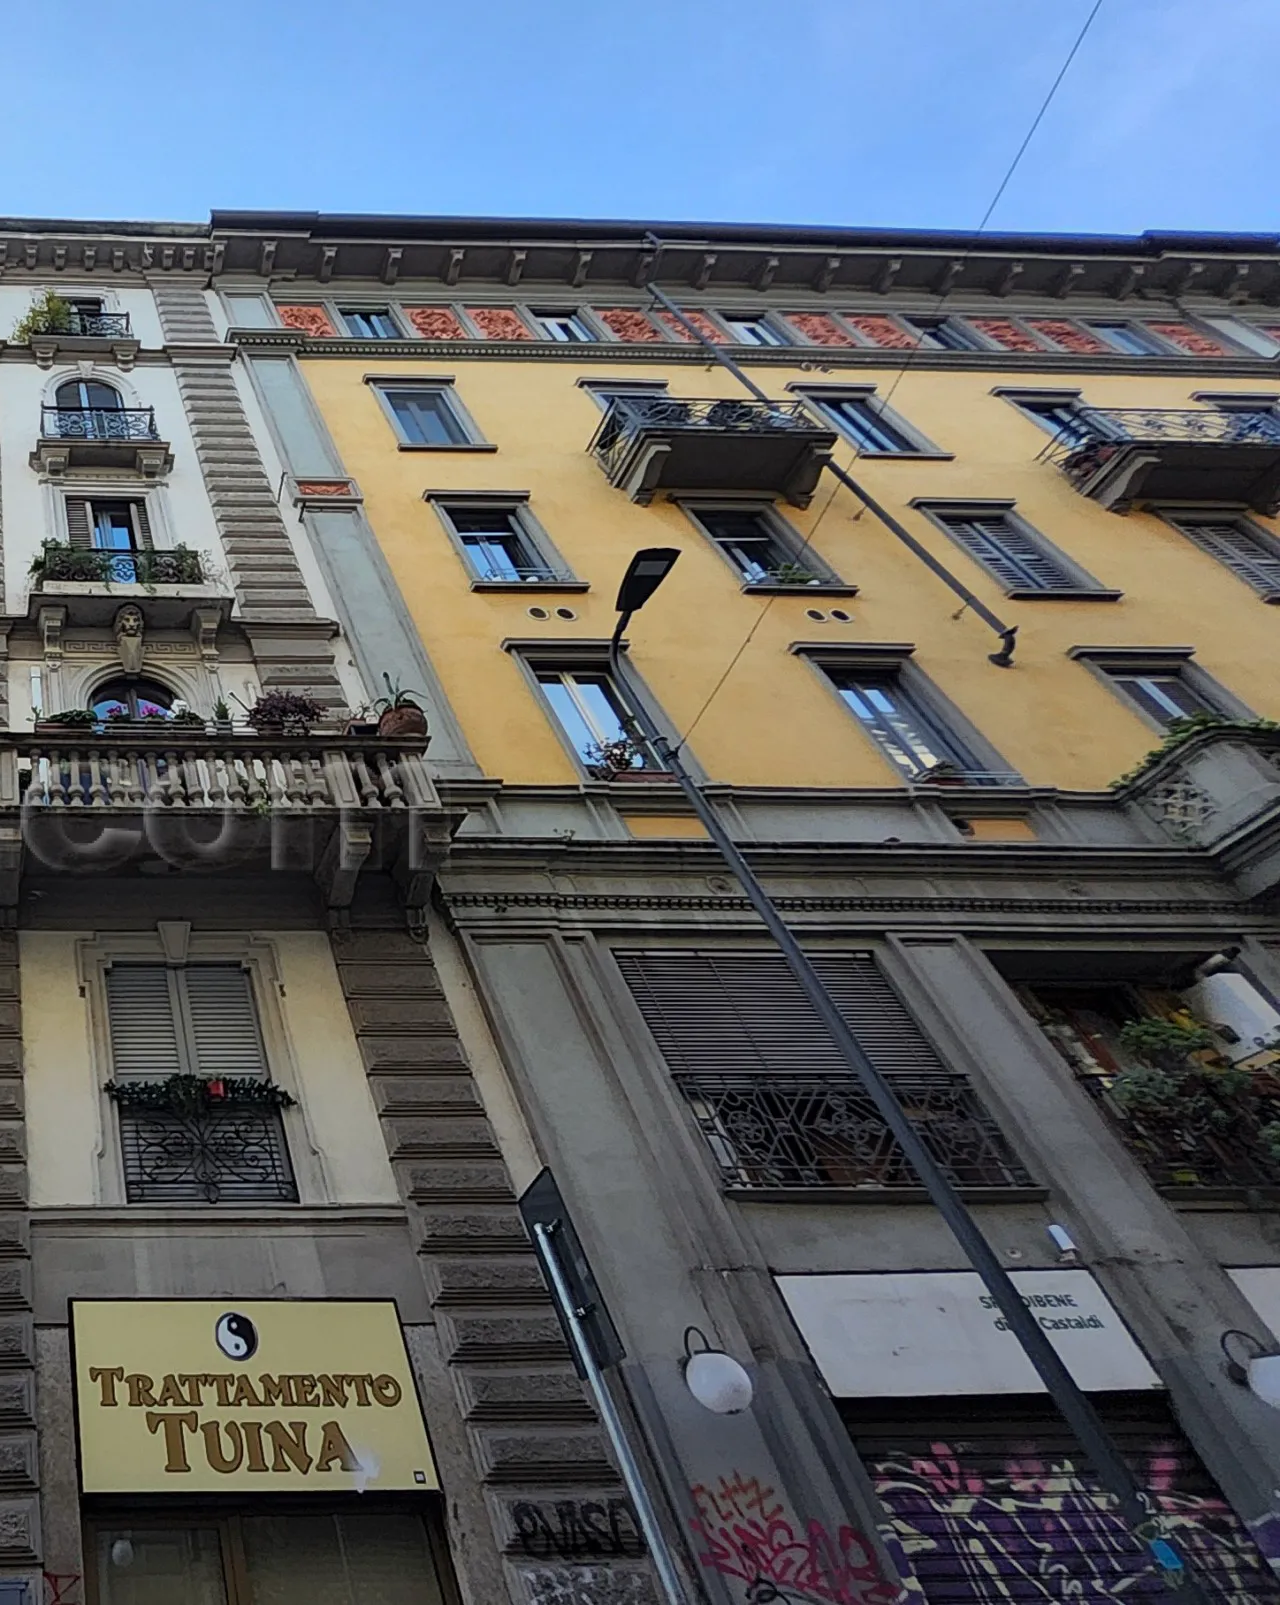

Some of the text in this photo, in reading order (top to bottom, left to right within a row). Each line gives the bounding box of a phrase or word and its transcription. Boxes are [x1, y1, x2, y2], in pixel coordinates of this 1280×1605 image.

[1038, 1314, 1105, 1330] Castaldi
[89, 1366, 403, 1409] TRATTAMENTO
[146, 1411, 366, 1475] TUINA
